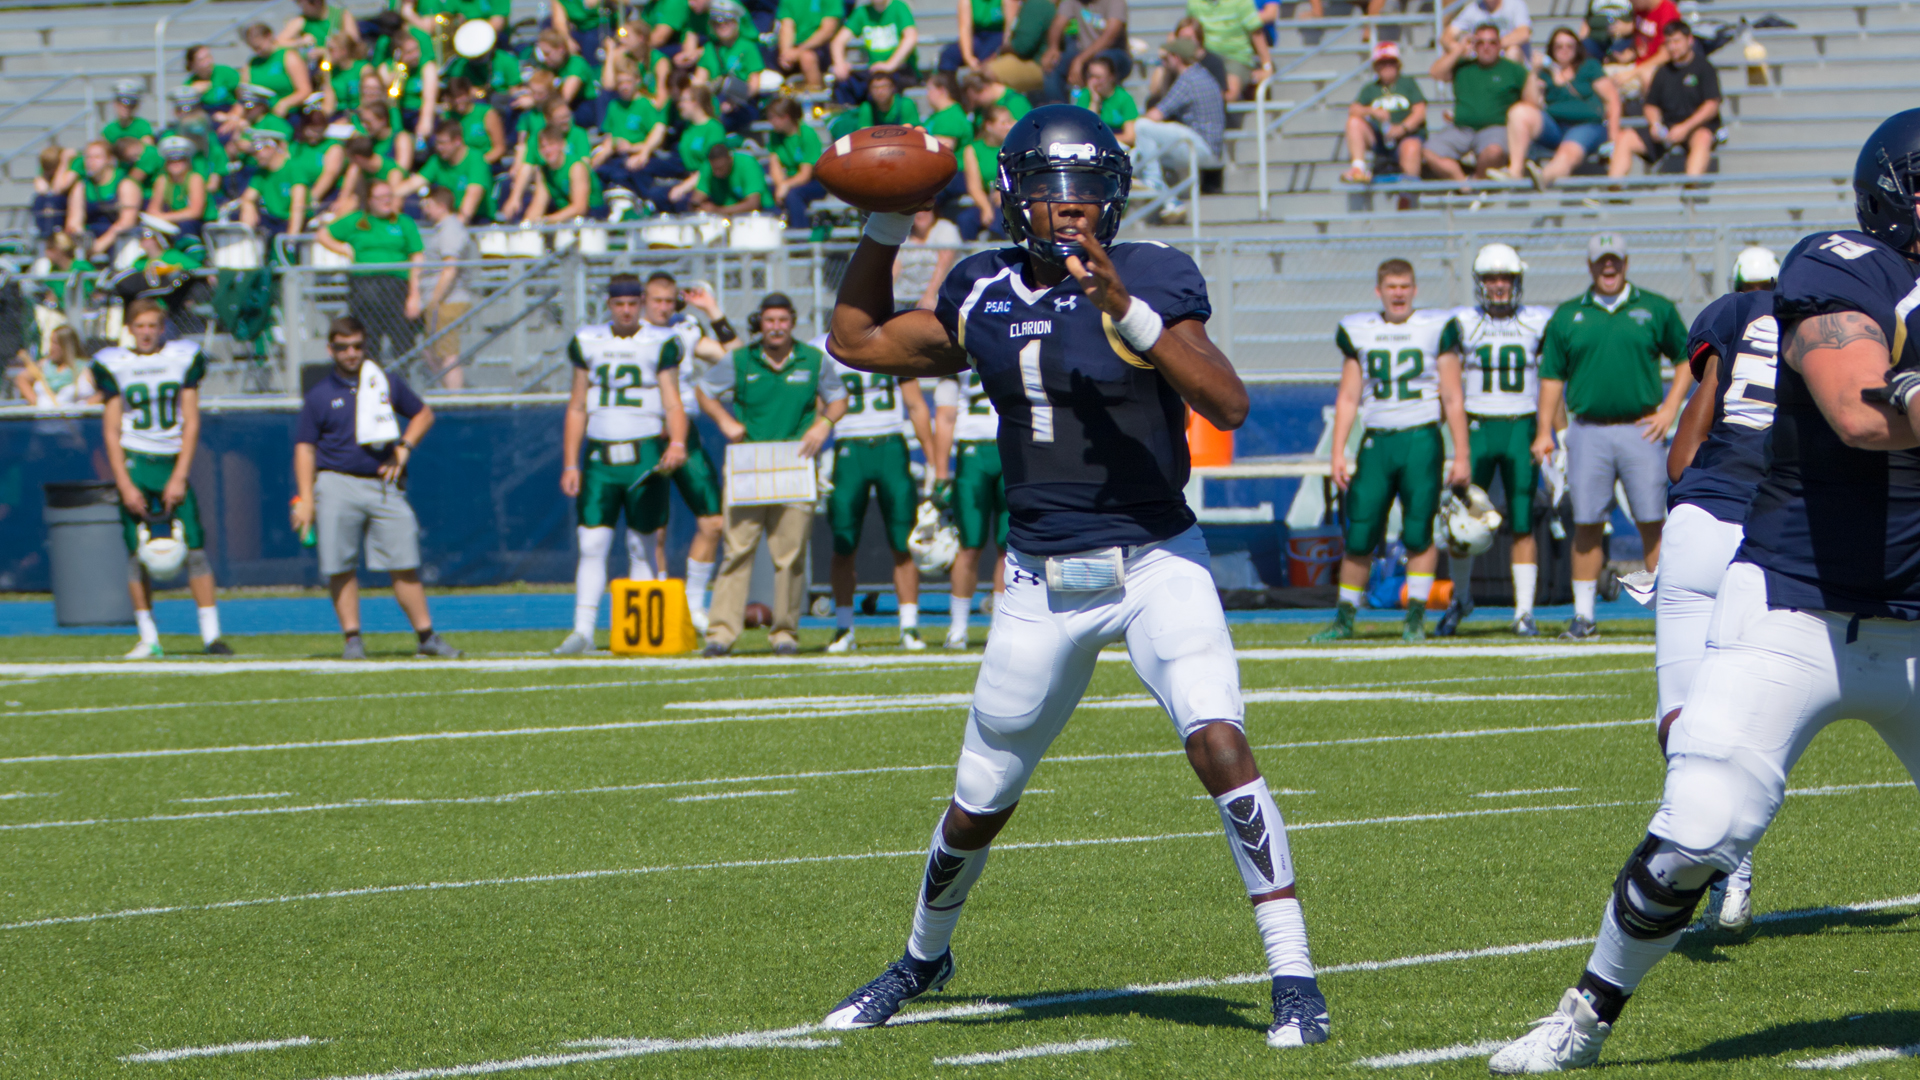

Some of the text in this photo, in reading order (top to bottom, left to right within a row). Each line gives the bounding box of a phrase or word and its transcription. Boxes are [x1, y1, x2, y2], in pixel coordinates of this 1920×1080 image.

[984, 301, 1012, 313] PSAC
[1010, 320, 1052, 338] CLARION
[596, 363, 643, 407] 12
[1019, 339, 1054, 442] 1
[1367, 348, 1424, 401] 92
[1475, 343, 1527, 393] 10
[126, 381, 180, 430] 90
[623, 587, 665, 647] 50
